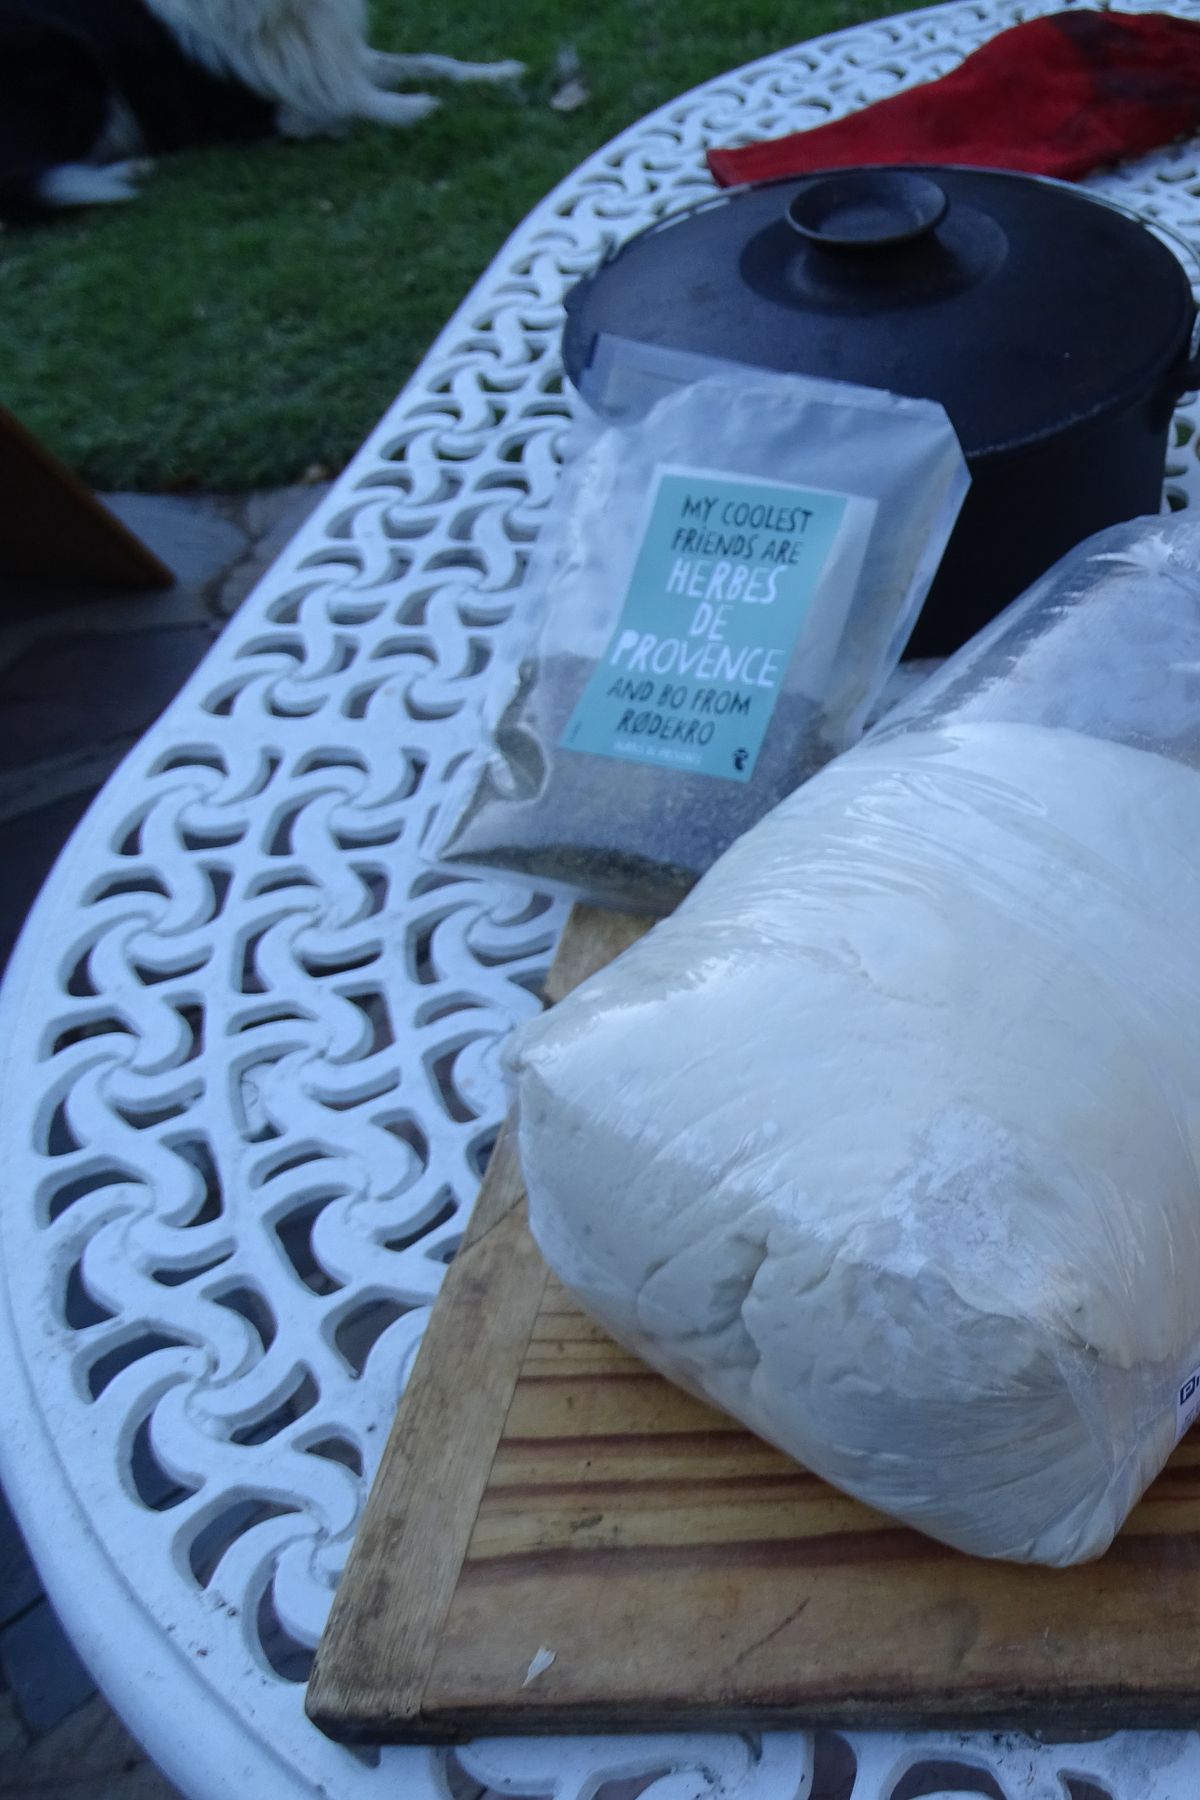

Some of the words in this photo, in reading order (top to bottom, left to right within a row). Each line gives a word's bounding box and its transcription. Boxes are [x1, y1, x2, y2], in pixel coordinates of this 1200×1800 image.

[681, 495, 717, 521] MY
[723, 502, 812, 533] COOLEST
[672, 528, 756, 558] FRIENDS
[760, 538, 804, 564] ARE
[667, 559, 786, 603] HERBES
[689, 602, 732, 641] DE
[611, 630, 784, 687] PROVENCE
[607, 677, 654, 703] AND
[659, 685, 688, 711] BO
[690, 691, 751, 717] FROM
